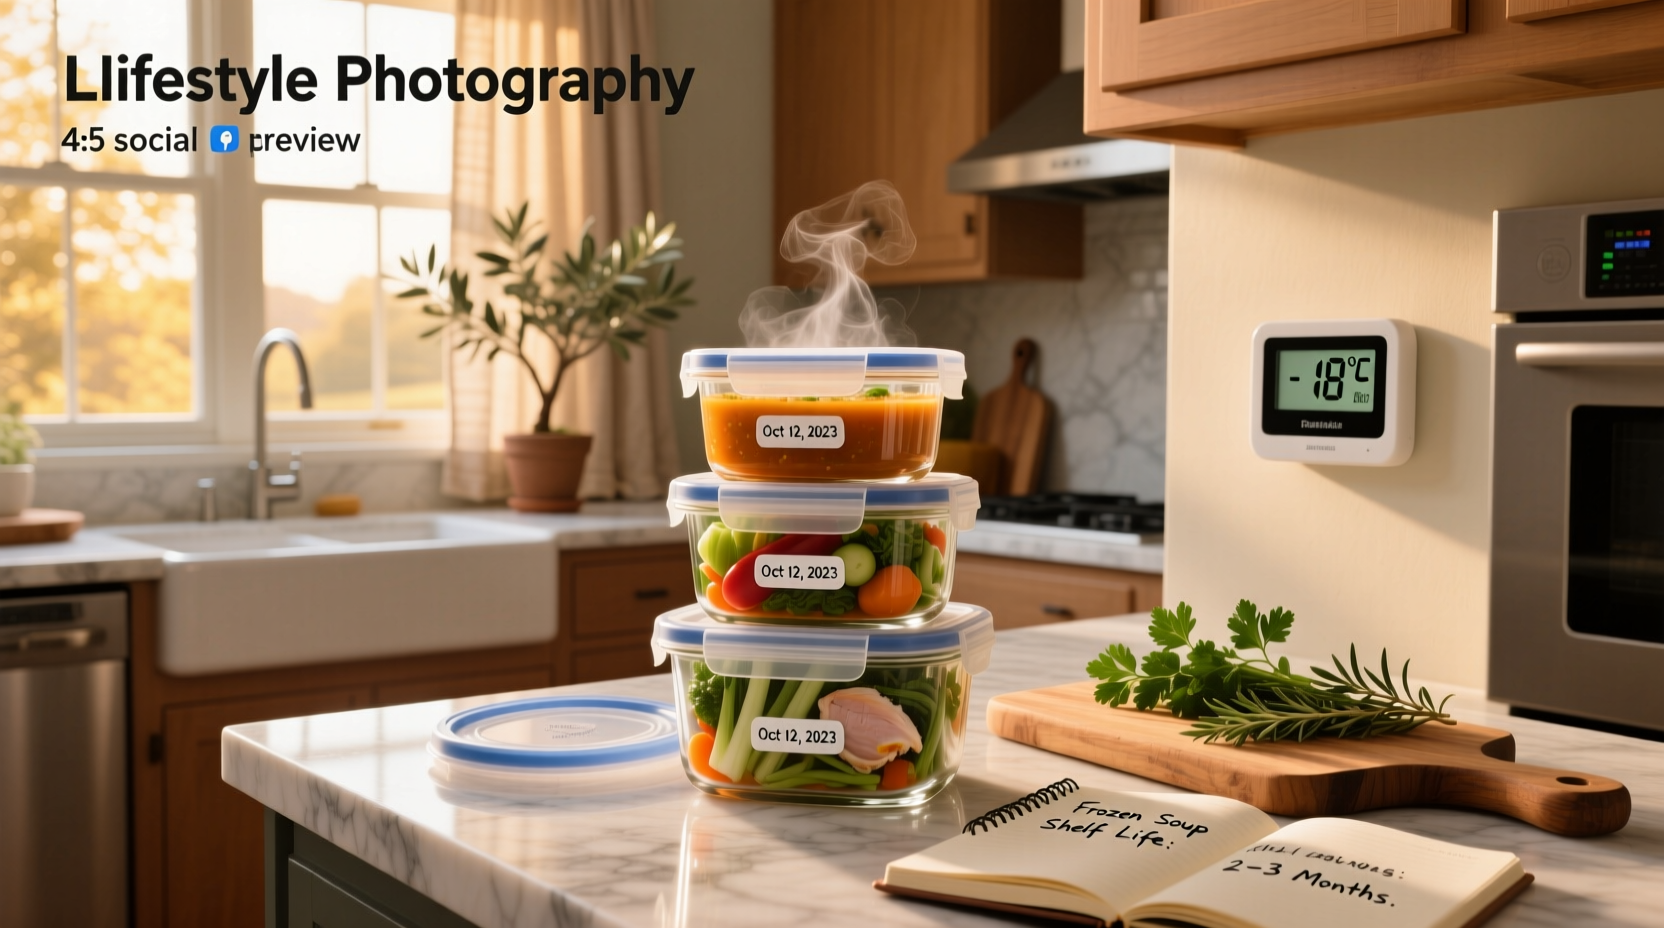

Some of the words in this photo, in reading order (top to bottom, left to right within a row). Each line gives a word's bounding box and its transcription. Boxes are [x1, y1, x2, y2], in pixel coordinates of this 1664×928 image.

[763, 424, 784, 438] Oct
[789, 425, 804, 441] 12,
[807, 425, 838, 438] 2023
[761, 564, 784, 578] Oct
[788, 565, 804, 581] 12,
[807, 566, 838, 579] 2023
[758, 727, 781, 741] Oct
[785, 729, 801, 745] 12,
[805, 730, 837, 744] 2023
[1072, 801, 1142, 821] Frozen
[1154, 813, 1209, 838] Soup
[1040, 818, 1109, 839] Shelf
[1115, 825, 1174, 849] Life:
[1222, 859, 1283, 876] 2-3
[1291, 869, 1395, 907] Months.
